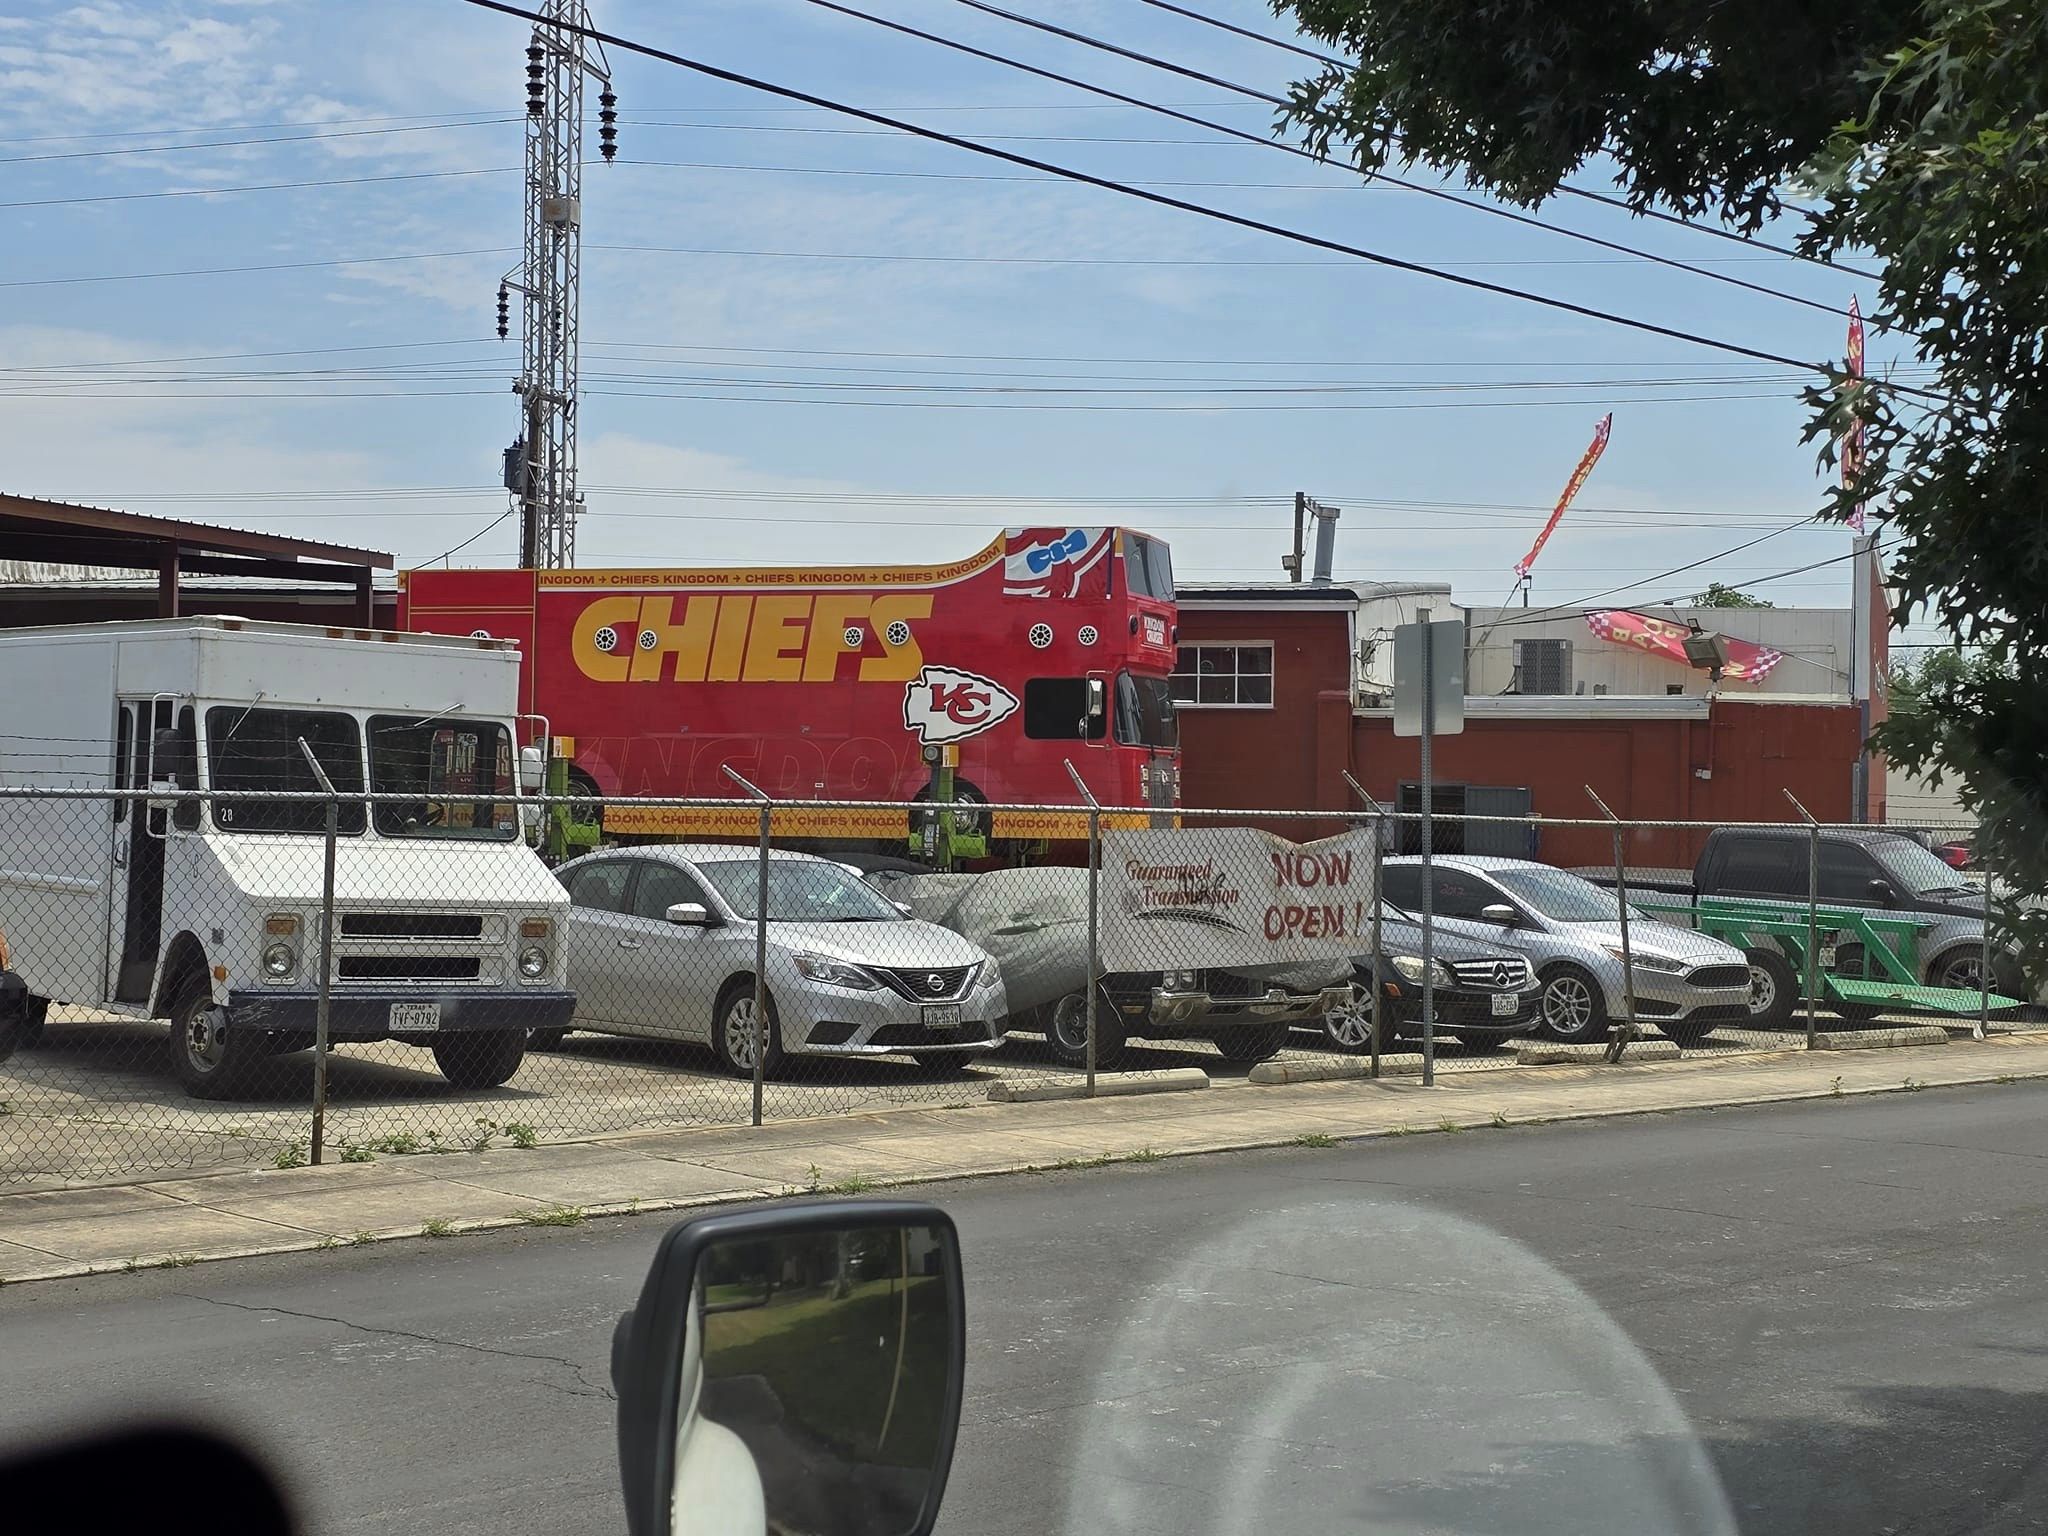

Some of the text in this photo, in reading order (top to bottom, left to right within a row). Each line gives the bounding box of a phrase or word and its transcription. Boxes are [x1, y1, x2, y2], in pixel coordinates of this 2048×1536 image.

[540, 545, 1001, 585] INGDOM CHIEFS KINGDOM CHIEFS KINGDOM CHIEFS KINGDOM
[572, 594, 934, 682] CHIEFS
[929, 683, 991, 725] KC
[603, 814, 645, 824] GDOM
[662, 815, 711, 825] CHIEFS
[713, 816, 781, 826] KINGDM
[797, 816, 848, 826] CHIEFS
[851, 817, 908, 827] KINGDO
[992, 819, 1060, 829] KINGDOM
[1271, 850, 1351, 888] NOW
